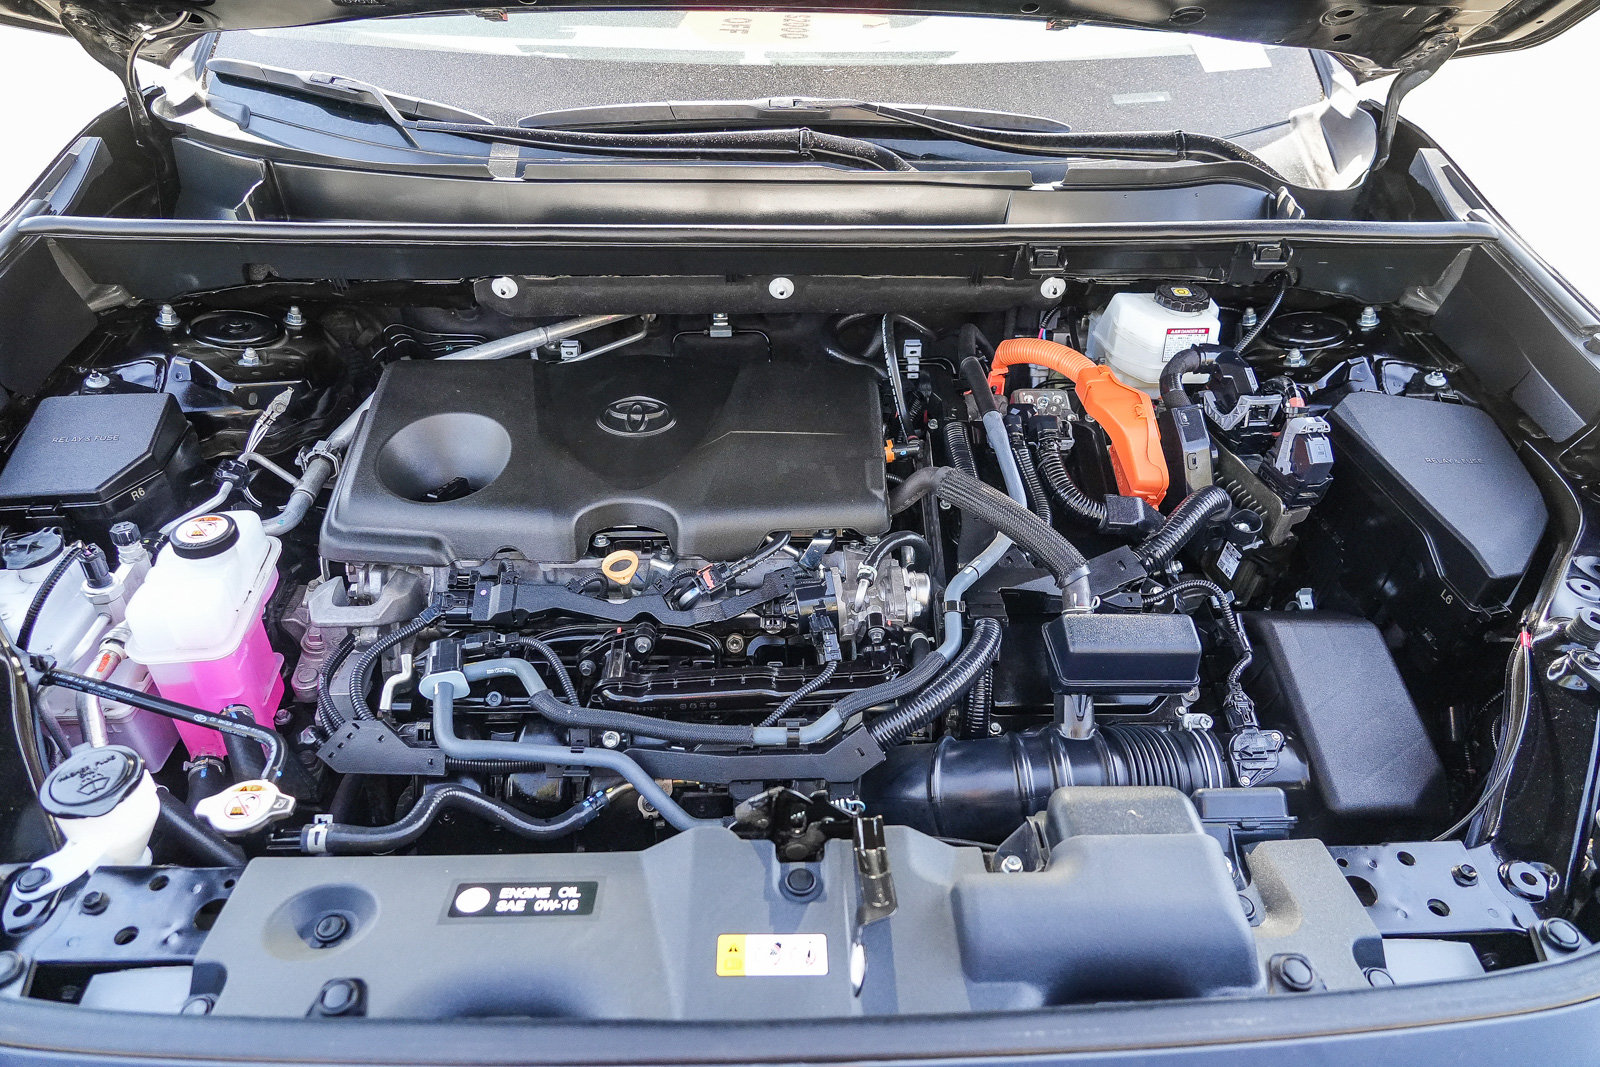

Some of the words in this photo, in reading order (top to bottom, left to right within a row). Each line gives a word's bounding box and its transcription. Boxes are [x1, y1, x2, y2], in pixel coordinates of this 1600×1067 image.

[720, 17, 752, 34] OFF
[94, 434, 120, 442] FUSE
[130, 487, 146, 501] R6
[1440, 588, 1453, 605] L6
[499, 886, 552, 900] ENGINE
[558, 886, 582, 899] OIL
[495, 899, 527, 913] SAE
[533, 899, 580, 912] 0W-16
